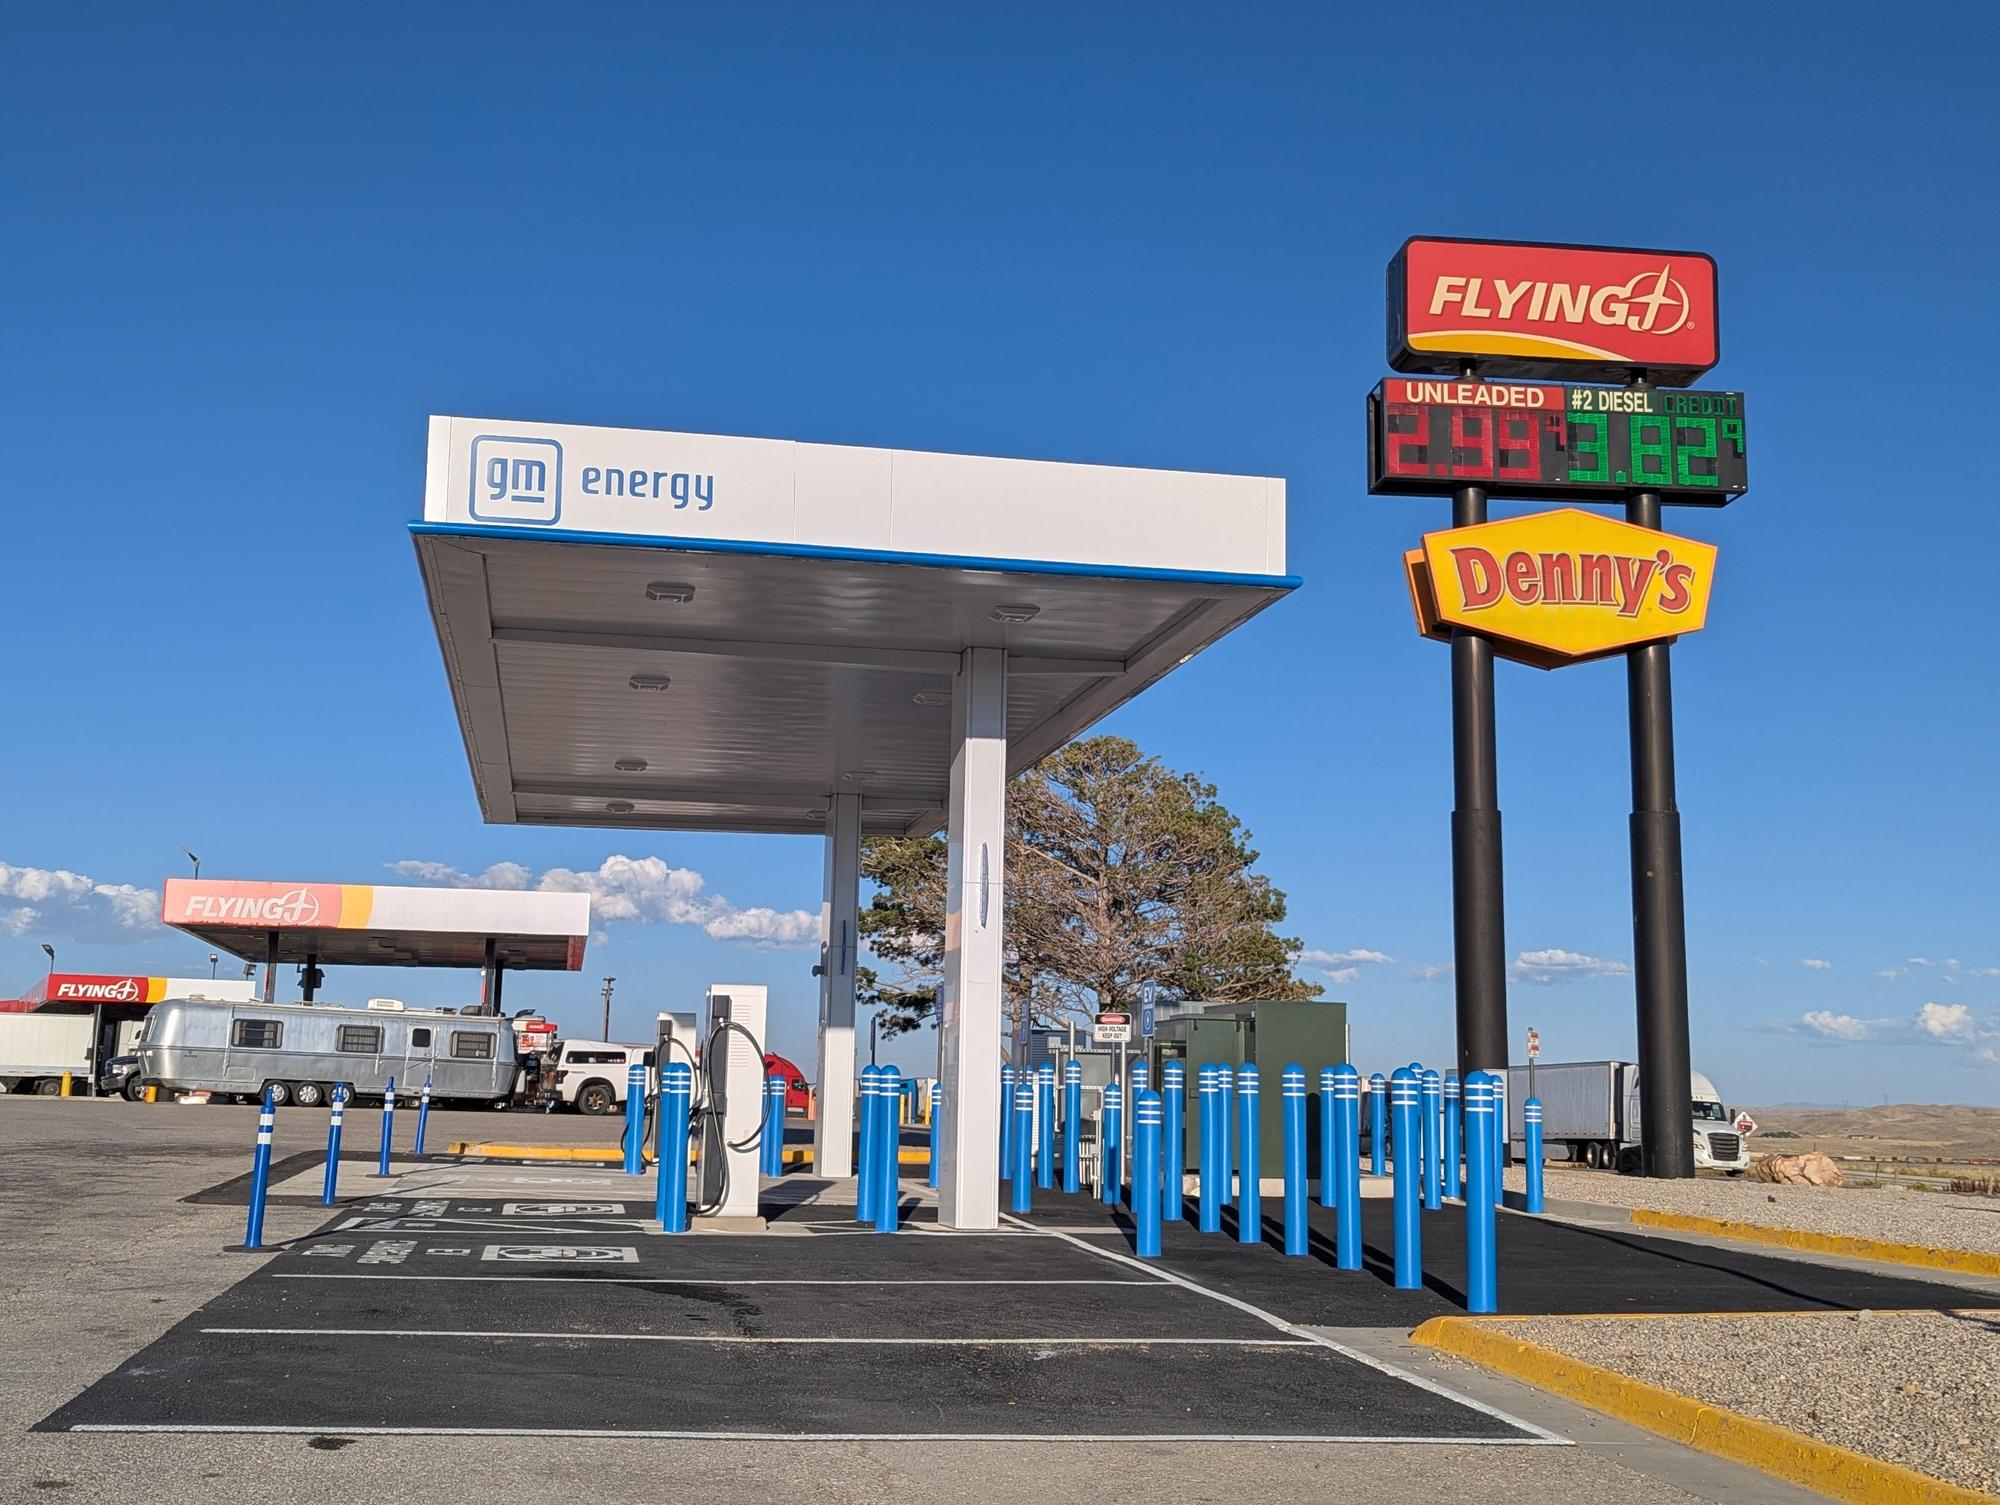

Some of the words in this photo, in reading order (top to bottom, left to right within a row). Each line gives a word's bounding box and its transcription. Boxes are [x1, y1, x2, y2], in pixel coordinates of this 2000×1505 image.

[1406, 381, 1545, 408] UNLEADED
[1571, 389, 1593, 411] #2
[1598, 390, 1654, 413] DIESEL
[1663, 394, 1738, 416] CREDIT
[486, 456, 547, 504] gm
[581, 466, 715, 512] energy
[1449, 546, 1695, 618] Denny's
